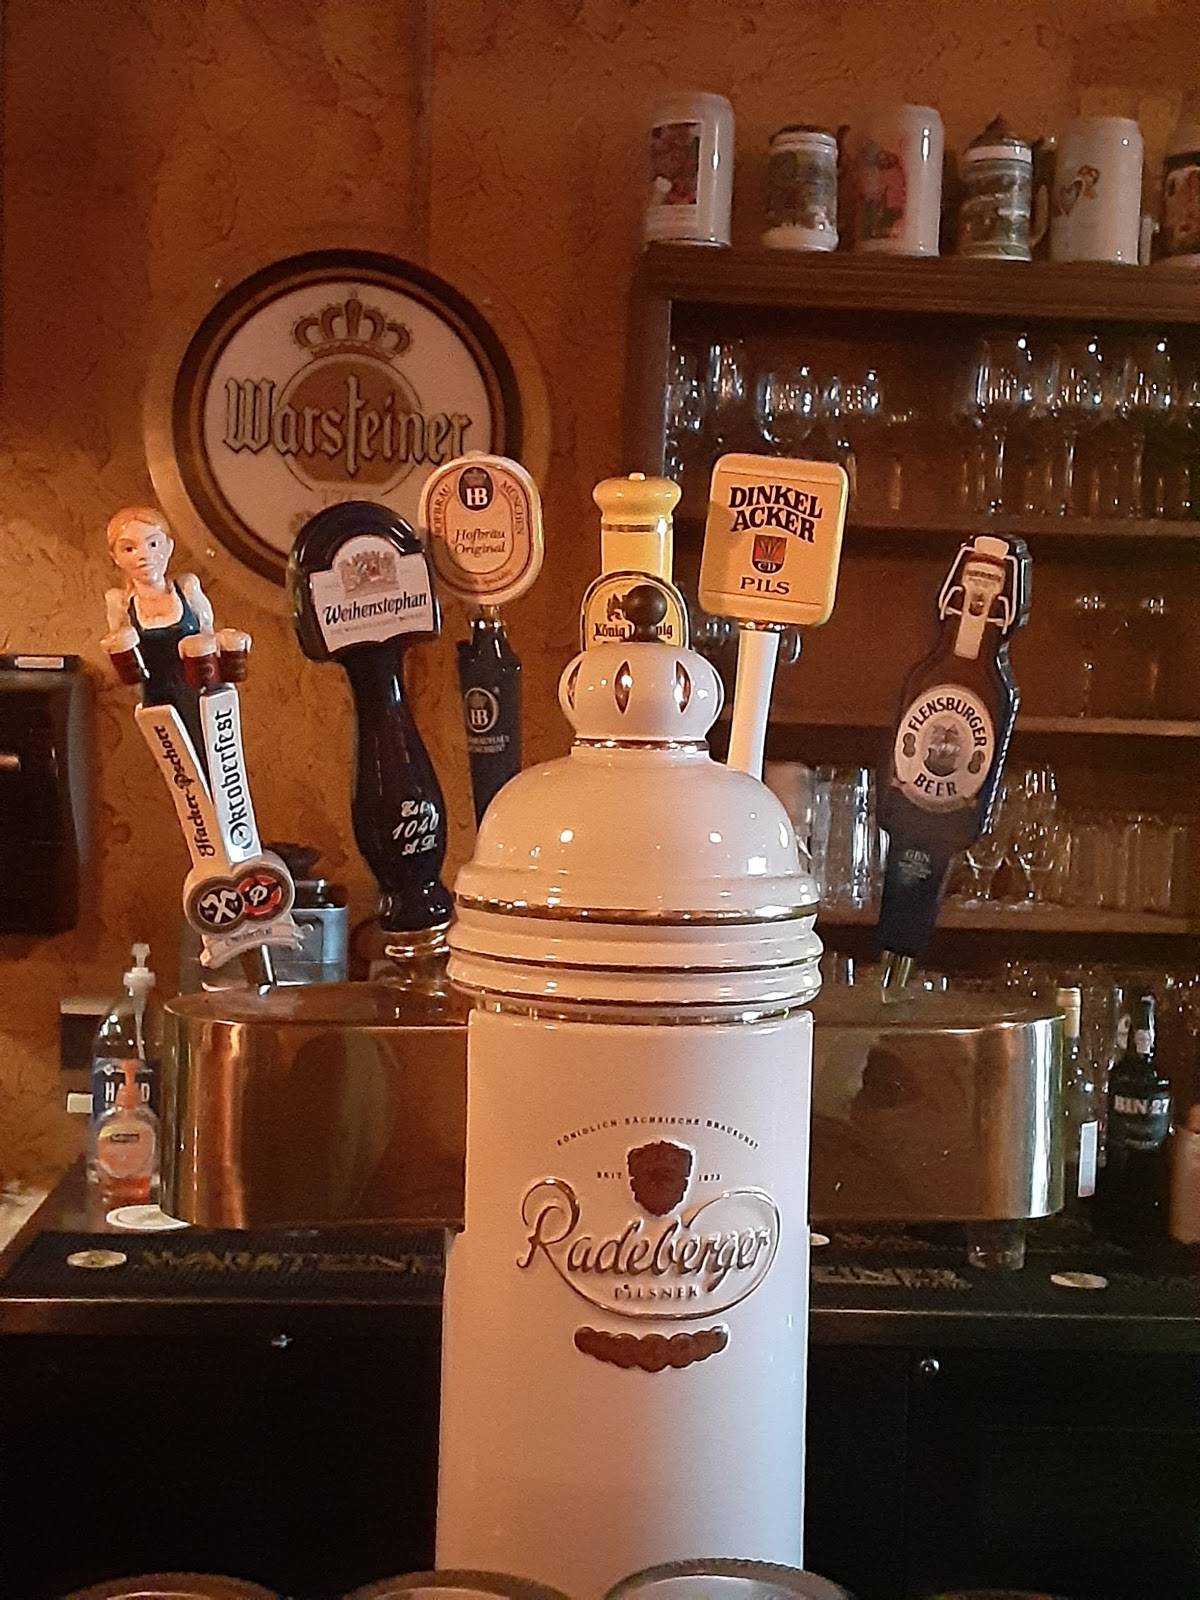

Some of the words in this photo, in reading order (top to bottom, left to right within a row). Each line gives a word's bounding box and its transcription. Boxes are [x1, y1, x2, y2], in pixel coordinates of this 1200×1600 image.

[222, 377, 473, 477] Warsteiner
[466, 487, 488, 506] HB
[728, 485, 824, 519] DINKEL
[730, 506, 816, 544] ACKER
[454, 543, 505, 558] Original
[740, 576, 790, 594] PILS
[324, 591, 427, 626] Weihenstephan
[907, 696, 988, 748] FLENSBURGER
[153, 724, 215, 857] Hacker-Pschorr
[214, 707, 252, 850] Oktoberfest
[914, 772, 958, 797] BEER
[392, 813, 440, 840] 1040
[105, 1081, 151, 1102] HD
[1114, 1094, 1148, 1114] BIN
[1150, 1098, 1170, 1114] 27
[515, 1175, 777, 1300] Radeberger
[614, 1284, 700, 1299] PILSNER
